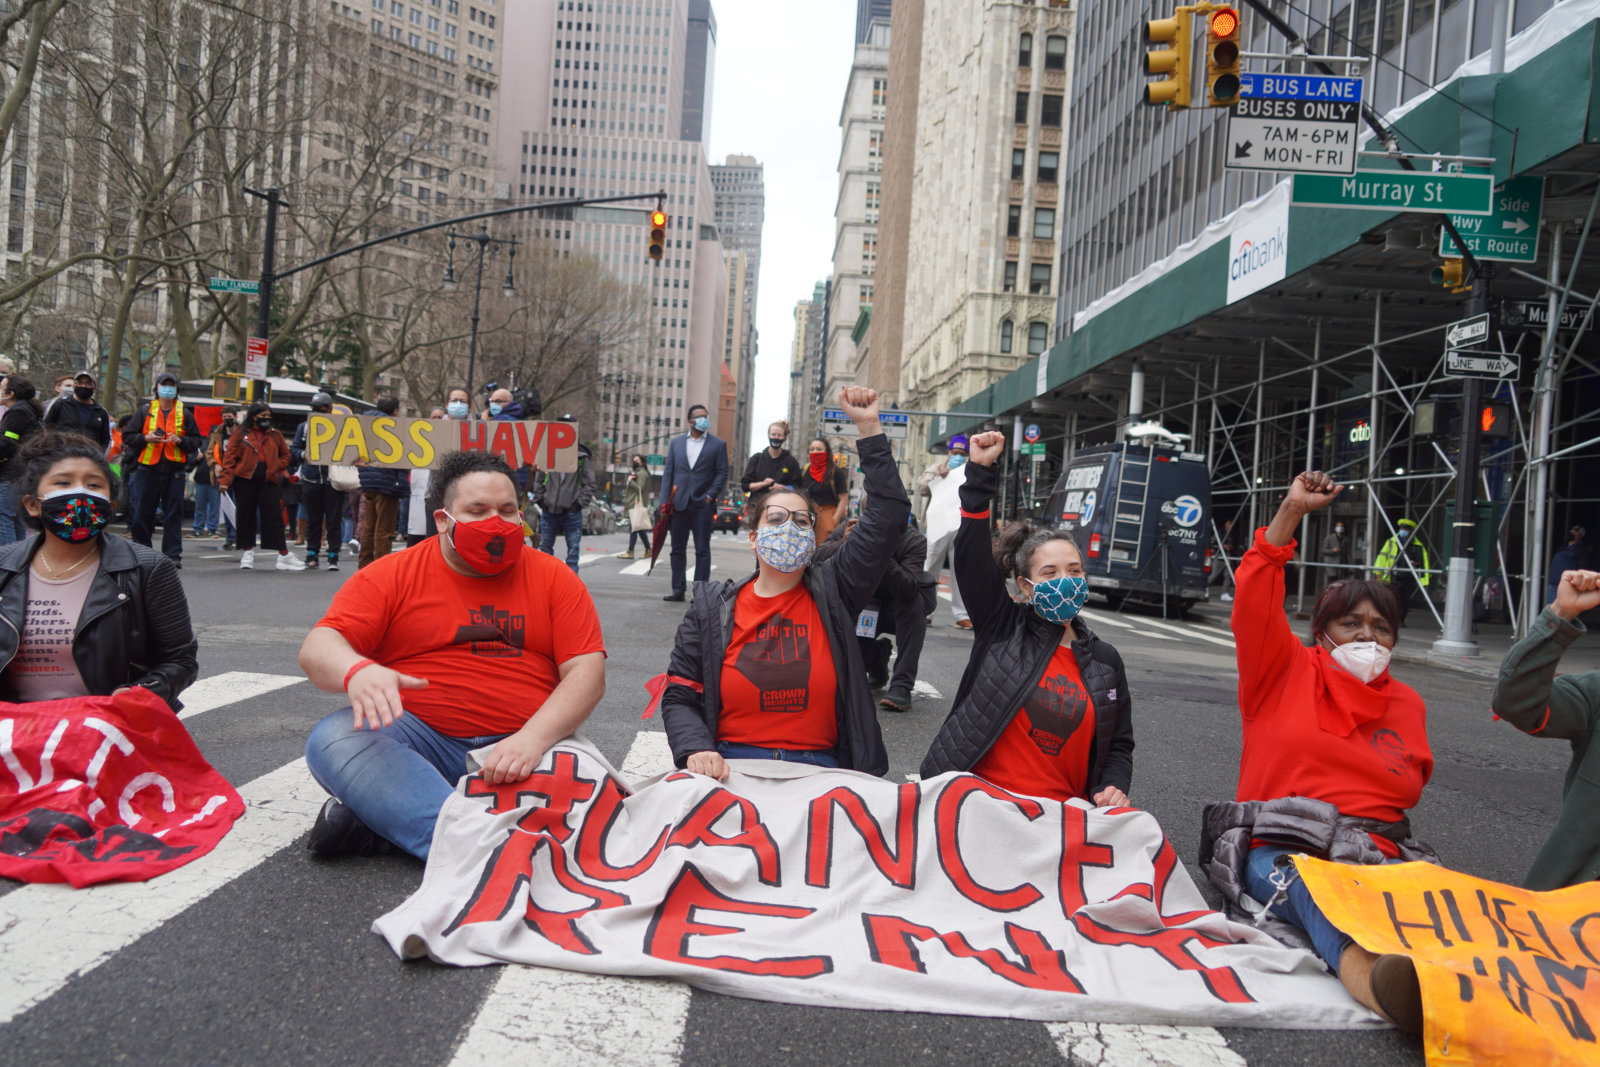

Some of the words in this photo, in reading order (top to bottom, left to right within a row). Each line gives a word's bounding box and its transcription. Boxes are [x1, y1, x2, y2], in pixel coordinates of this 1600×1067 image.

[1263, 78, 1299, 95] BUS
[1305, 80, 1355, 98] LANE
[1237, 100, 1297, 118] BUSES
[1304, 102, 1351, 120] ONLY
[1264, 147, 1343, 165] MON-FRI
[1342, 178, 1415, 206] Murray
[1423, 182, 1443, 202] St
[1499, 198, 1530, 212] Side
[1453, 215, 1482, 233] Hwy
[1231, 226, 1285, 281] citibank
[1449, 238, 1481, 251] Bst
[1487, 239, 1529, 254] Route
[210, 279, 227, 288] STEVE
[230, 280, 259, 290] FLANDERS
[1529, 307, 1577, 327] Muay
[1451, 329, 1464, 341] ONE
[1470, 323, 1485, 335] WAY
[1452, 359, 1474, 369] ONE
[1486, 361, 1509, 371] WAY
[308, 415, 435, 468] PASS
[459, 420, 577, 471] HAVP
[25, 608, 63, 616] ends.
[24, 618, 71, 626] thers.
[763, 688, 805, 700] CROWN
[1047, 681, 1087, 701] CHTU
[763, 698, 805, 706] HEIGHTS
